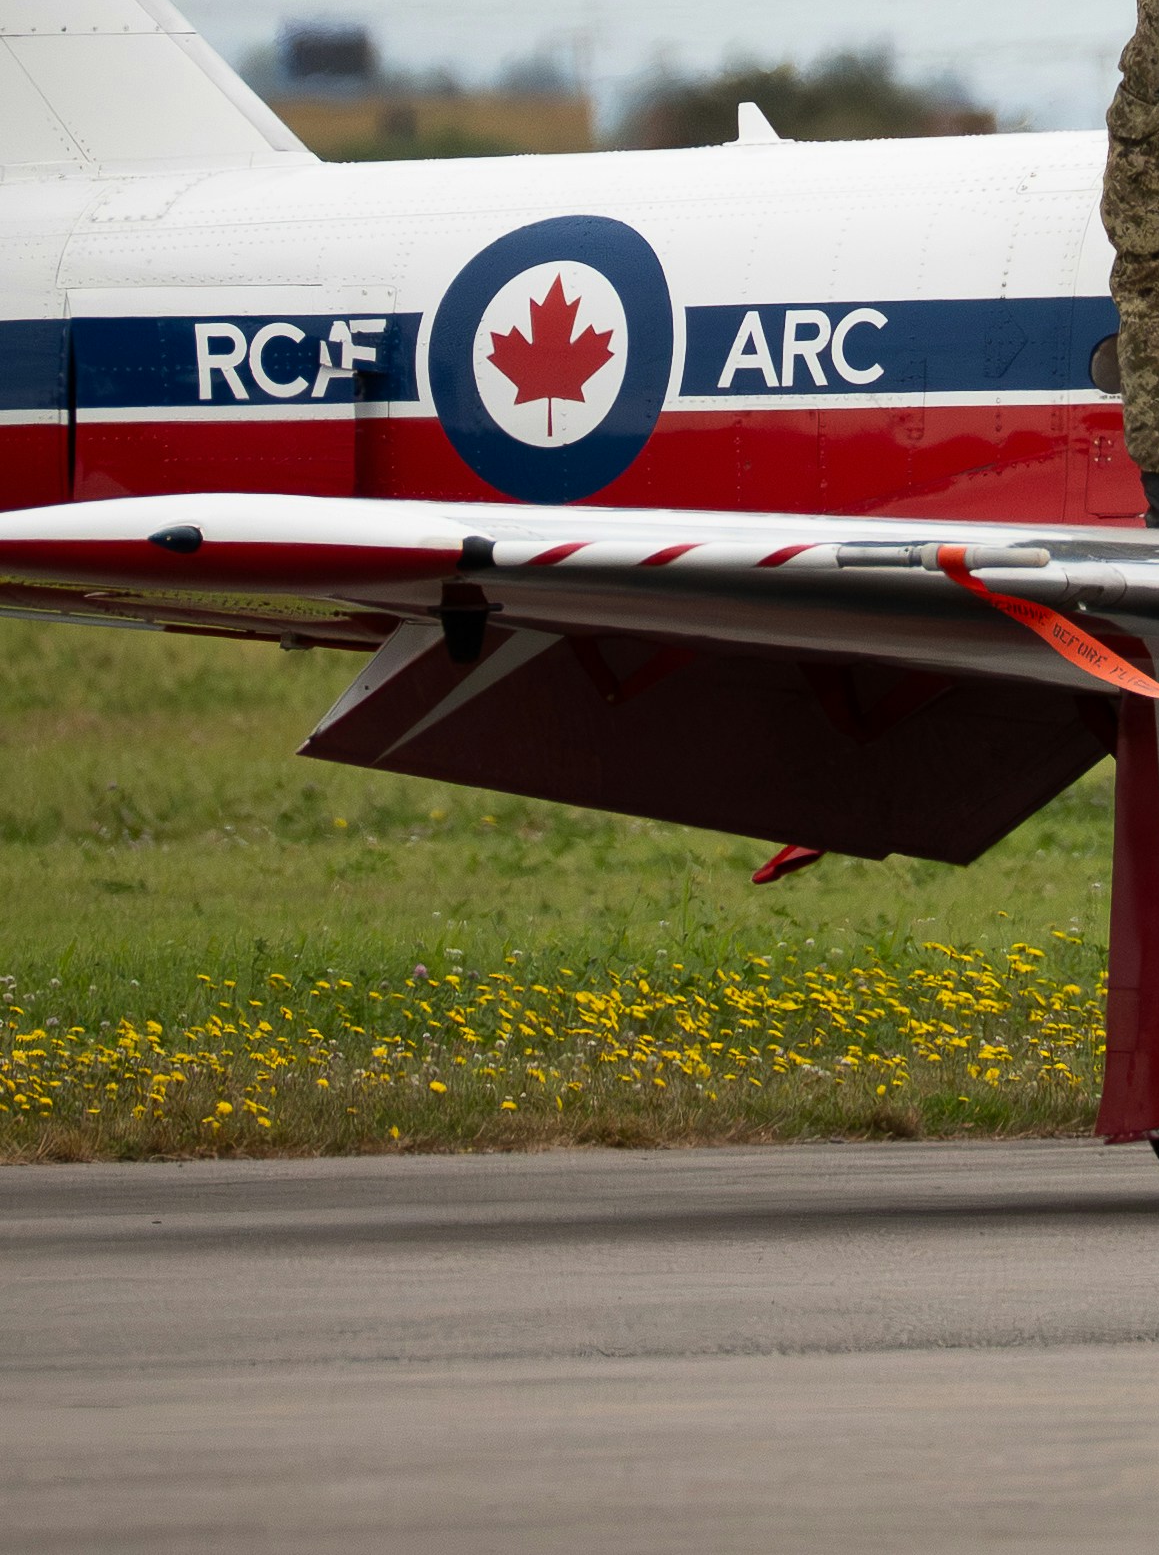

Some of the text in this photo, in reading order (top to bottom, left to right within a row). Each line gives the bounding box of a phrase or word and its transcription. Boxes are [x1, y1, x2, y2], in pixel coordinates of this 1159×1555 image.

[195, 318, 387, 400] RCAF
[717, 307, 889, 388] ARC
[1052, 622, 1108, 668] BEFORE
